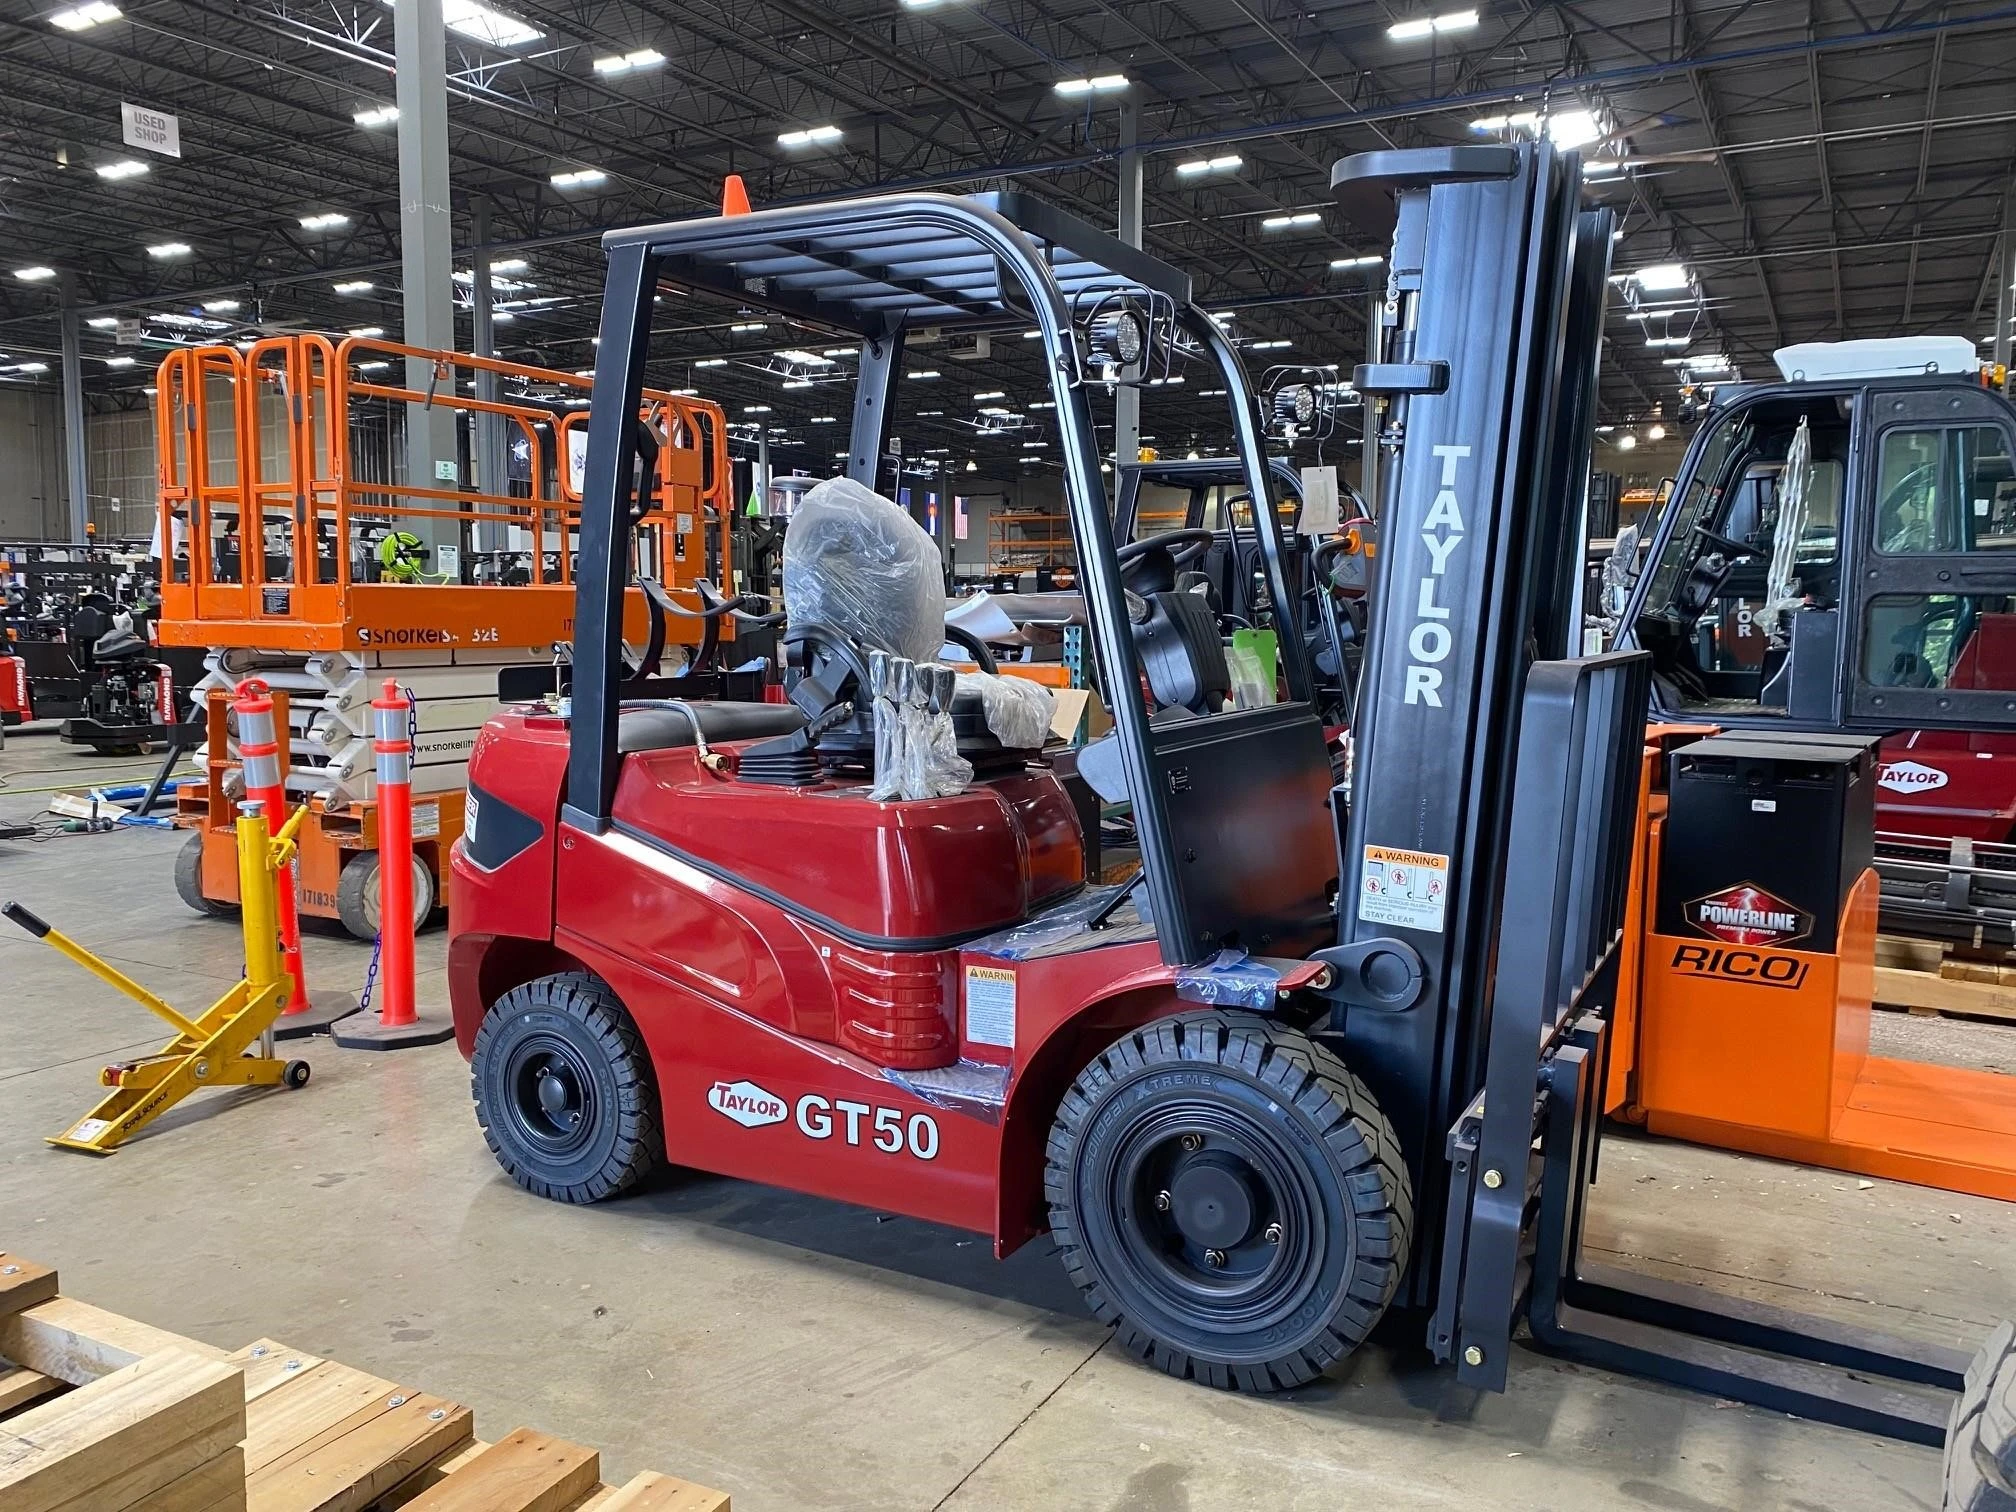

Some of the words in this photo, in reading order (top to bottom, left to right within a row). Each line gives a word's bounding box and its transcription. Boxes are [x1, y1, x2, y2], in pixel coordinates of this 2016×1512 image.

[134, 111, 166, 130] USED
[134, 126, 167, 144] SHOP
[1404, 445, 1471, 708] TAYLOR
[1737, 597, 1752, 637] LOR
[16, 667, 25, 706] RAYMOND
[163, 677, 171, 720] RAYMOND
[415, 739, 477, 753] ww.snorkellift
[1878, 765, 1940, 785] TAYLOR
[1386, 851, 1439, 867] WARNING
[303, 889, 336, 908] 171839
[1365, 910, 1386, 919] STAY
[1387, 913, 1415, 924] CLEAR
[1700, 904, 1795, 932] POWERLINE
[1750, 928, 1777, 936] POWER
[1671, 944, 1800, 982] RICO
[980, 969, 1015, 982] WARNIN
[716, 1084, 780, 1118] TAYLOR
[796, 1094, 940, 1160] GT50
